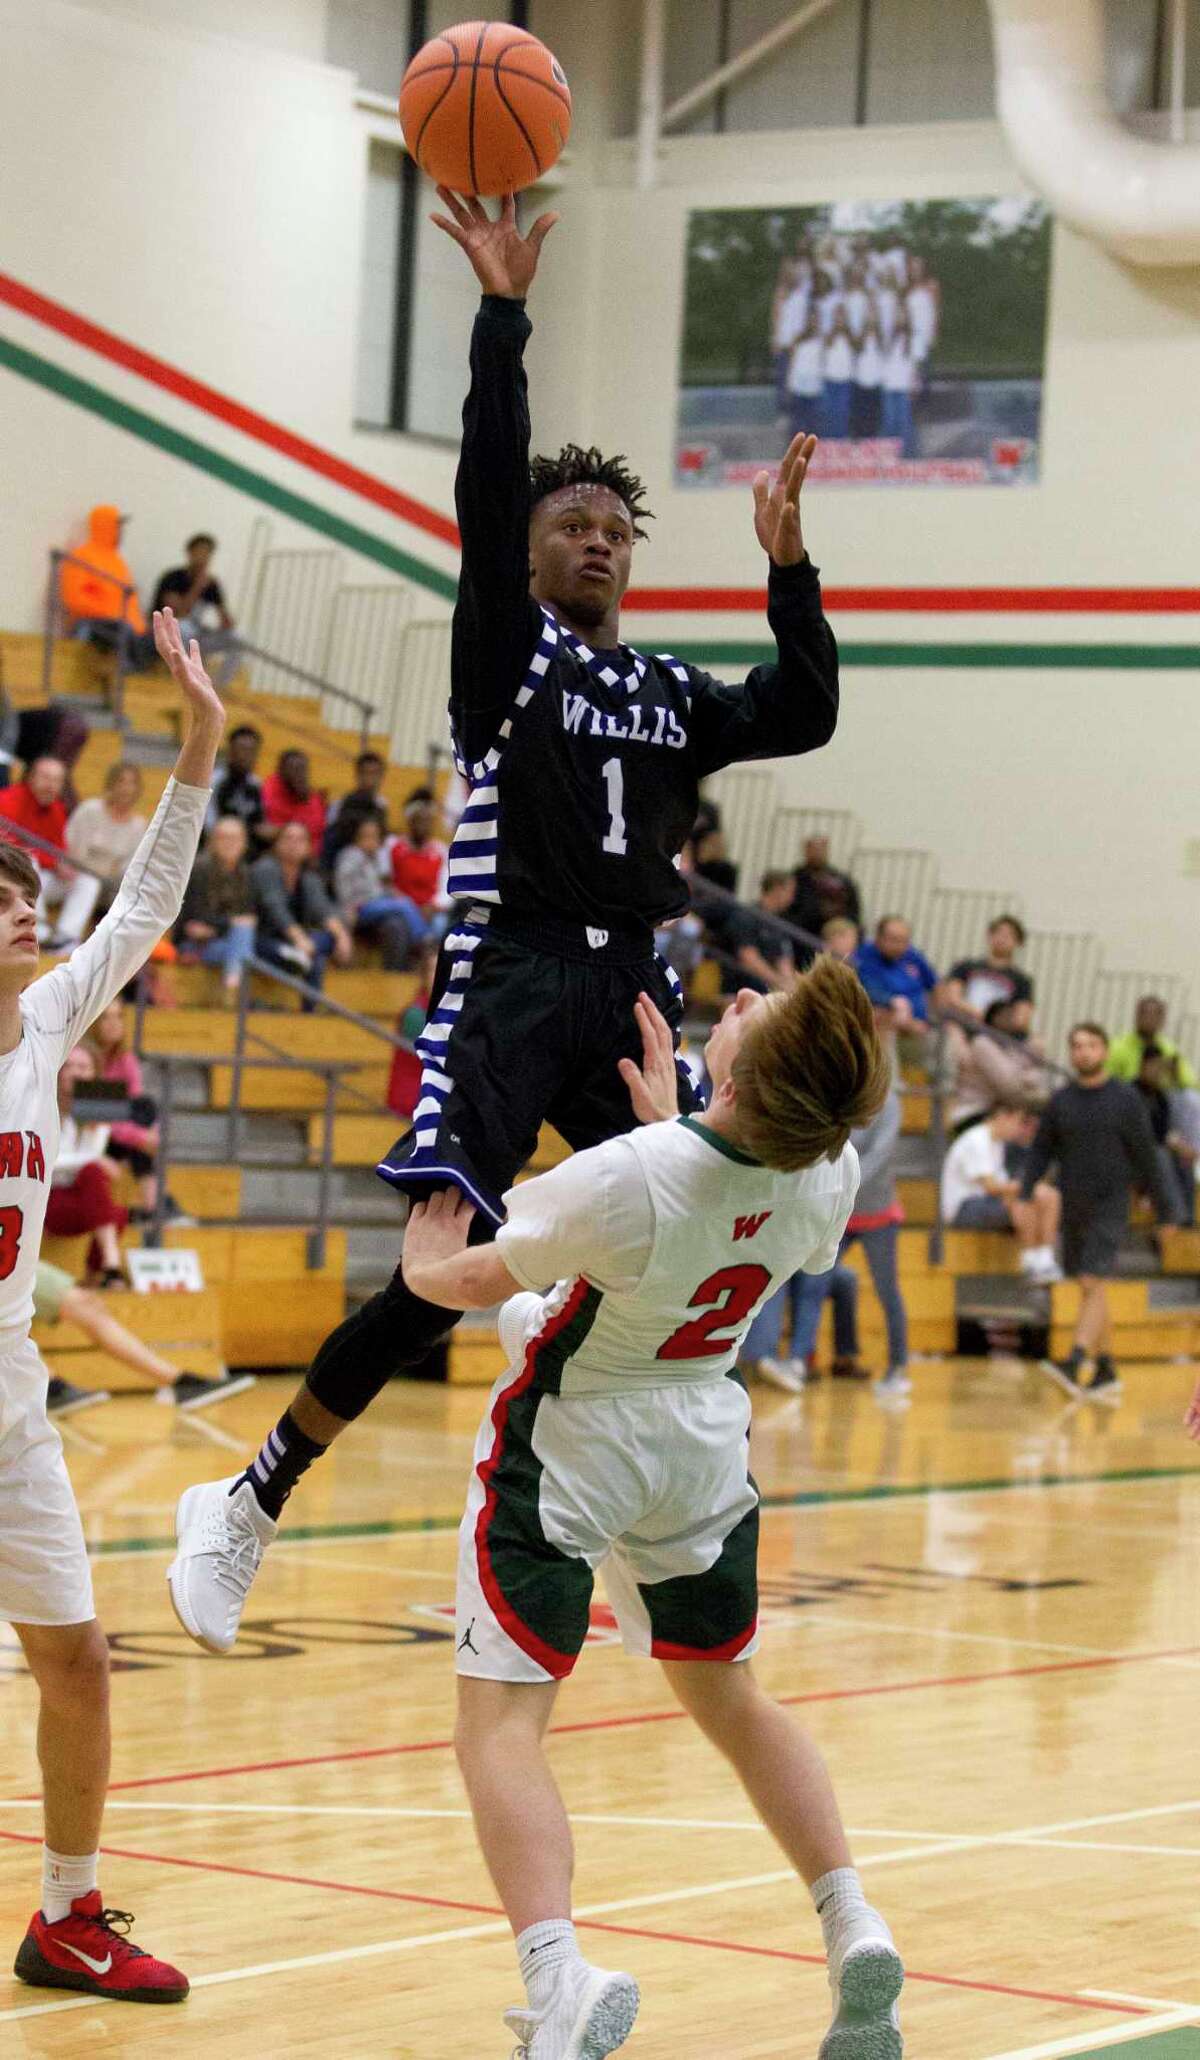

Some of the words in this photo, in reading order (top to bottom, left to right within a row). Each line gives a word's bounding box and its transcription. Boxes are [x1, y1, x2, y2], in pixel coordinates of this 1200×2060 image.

[562, 689, 688, 749] WILLIS
[602, 757, 628, 855] 1
[732, 1210, 773, 1242] W
[656, 1262, 773, 1360] 2
